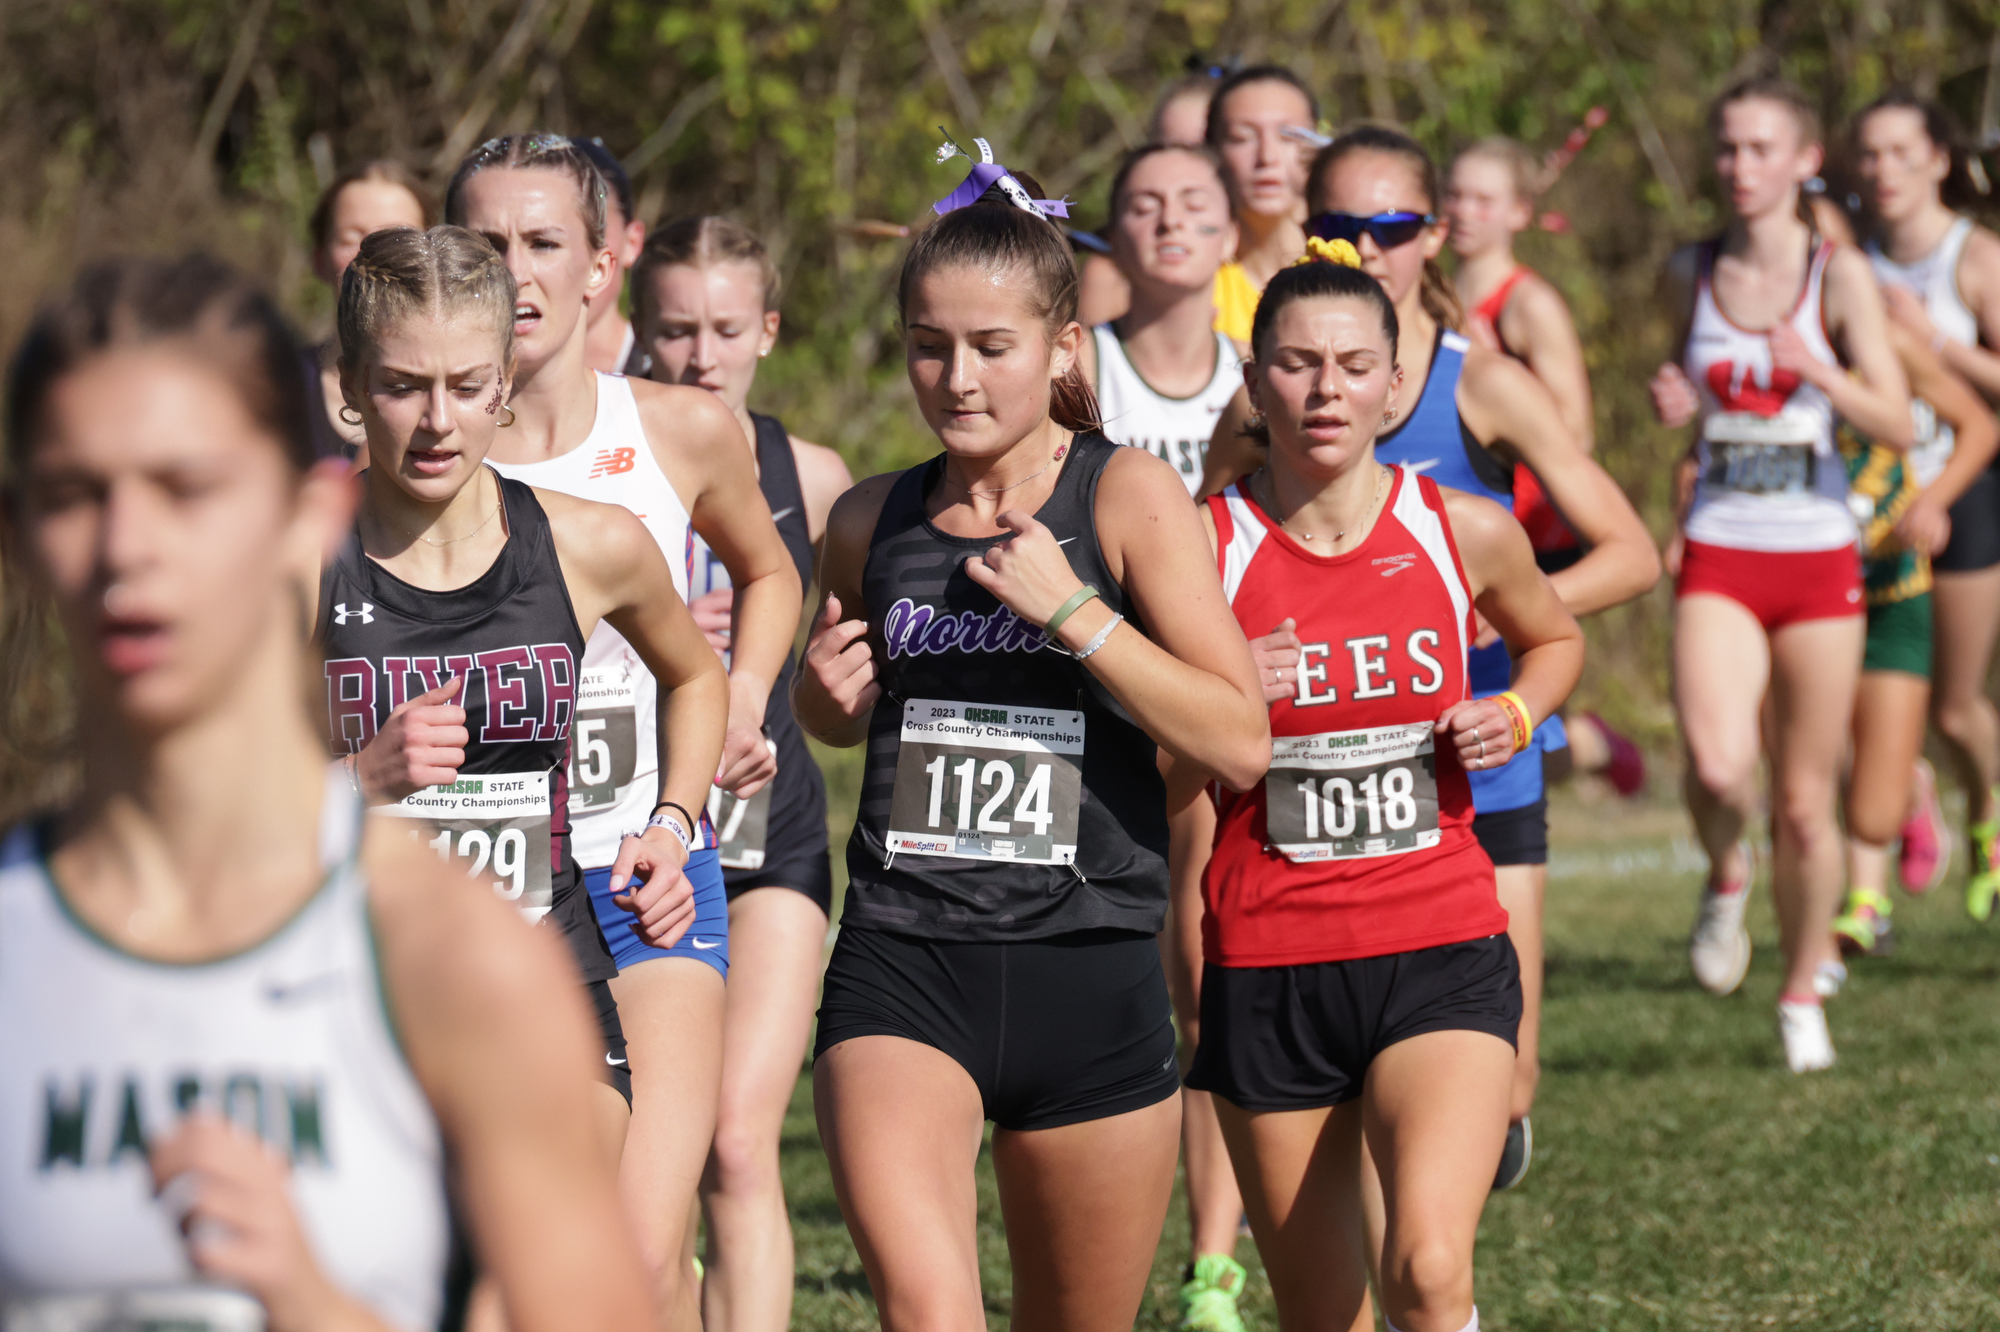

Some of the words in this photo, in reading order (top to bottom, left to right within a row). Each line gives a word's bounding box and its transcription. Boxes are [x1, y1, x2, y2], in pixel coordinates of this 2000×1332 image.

[579, 675, 604, 685] ATE
[931, 707, 956, 718] 2023
[964, 707, 1008, 724] OHSAA
[1014, 715, 1055, 726] STATE
[906, 720, 934, 731] Cross
[937, 722, 983, 737] Country
[986, 726, 1082, 745] Championships
[1292, 740, 1320, 749] 2023
[1328, 734, 1368, 748] OHSAA
[1374, 730, 1409, 742] STATE
[567, 718, 611, 788] 5
[1302, 752, 1347, 761] Country
[1350, 737, 1432, 758] Championships
[489, 781, 524, 792] STATE
[926, 755, 1053, 835] 1124
[407, 796, 457, 809] Country
[462, 794, 547, 809] Championships
[1298, 767, 1417, 838] 1018
[957, 831, 980, 840] 01124
[901, 839, 935, 852] MileSplit
